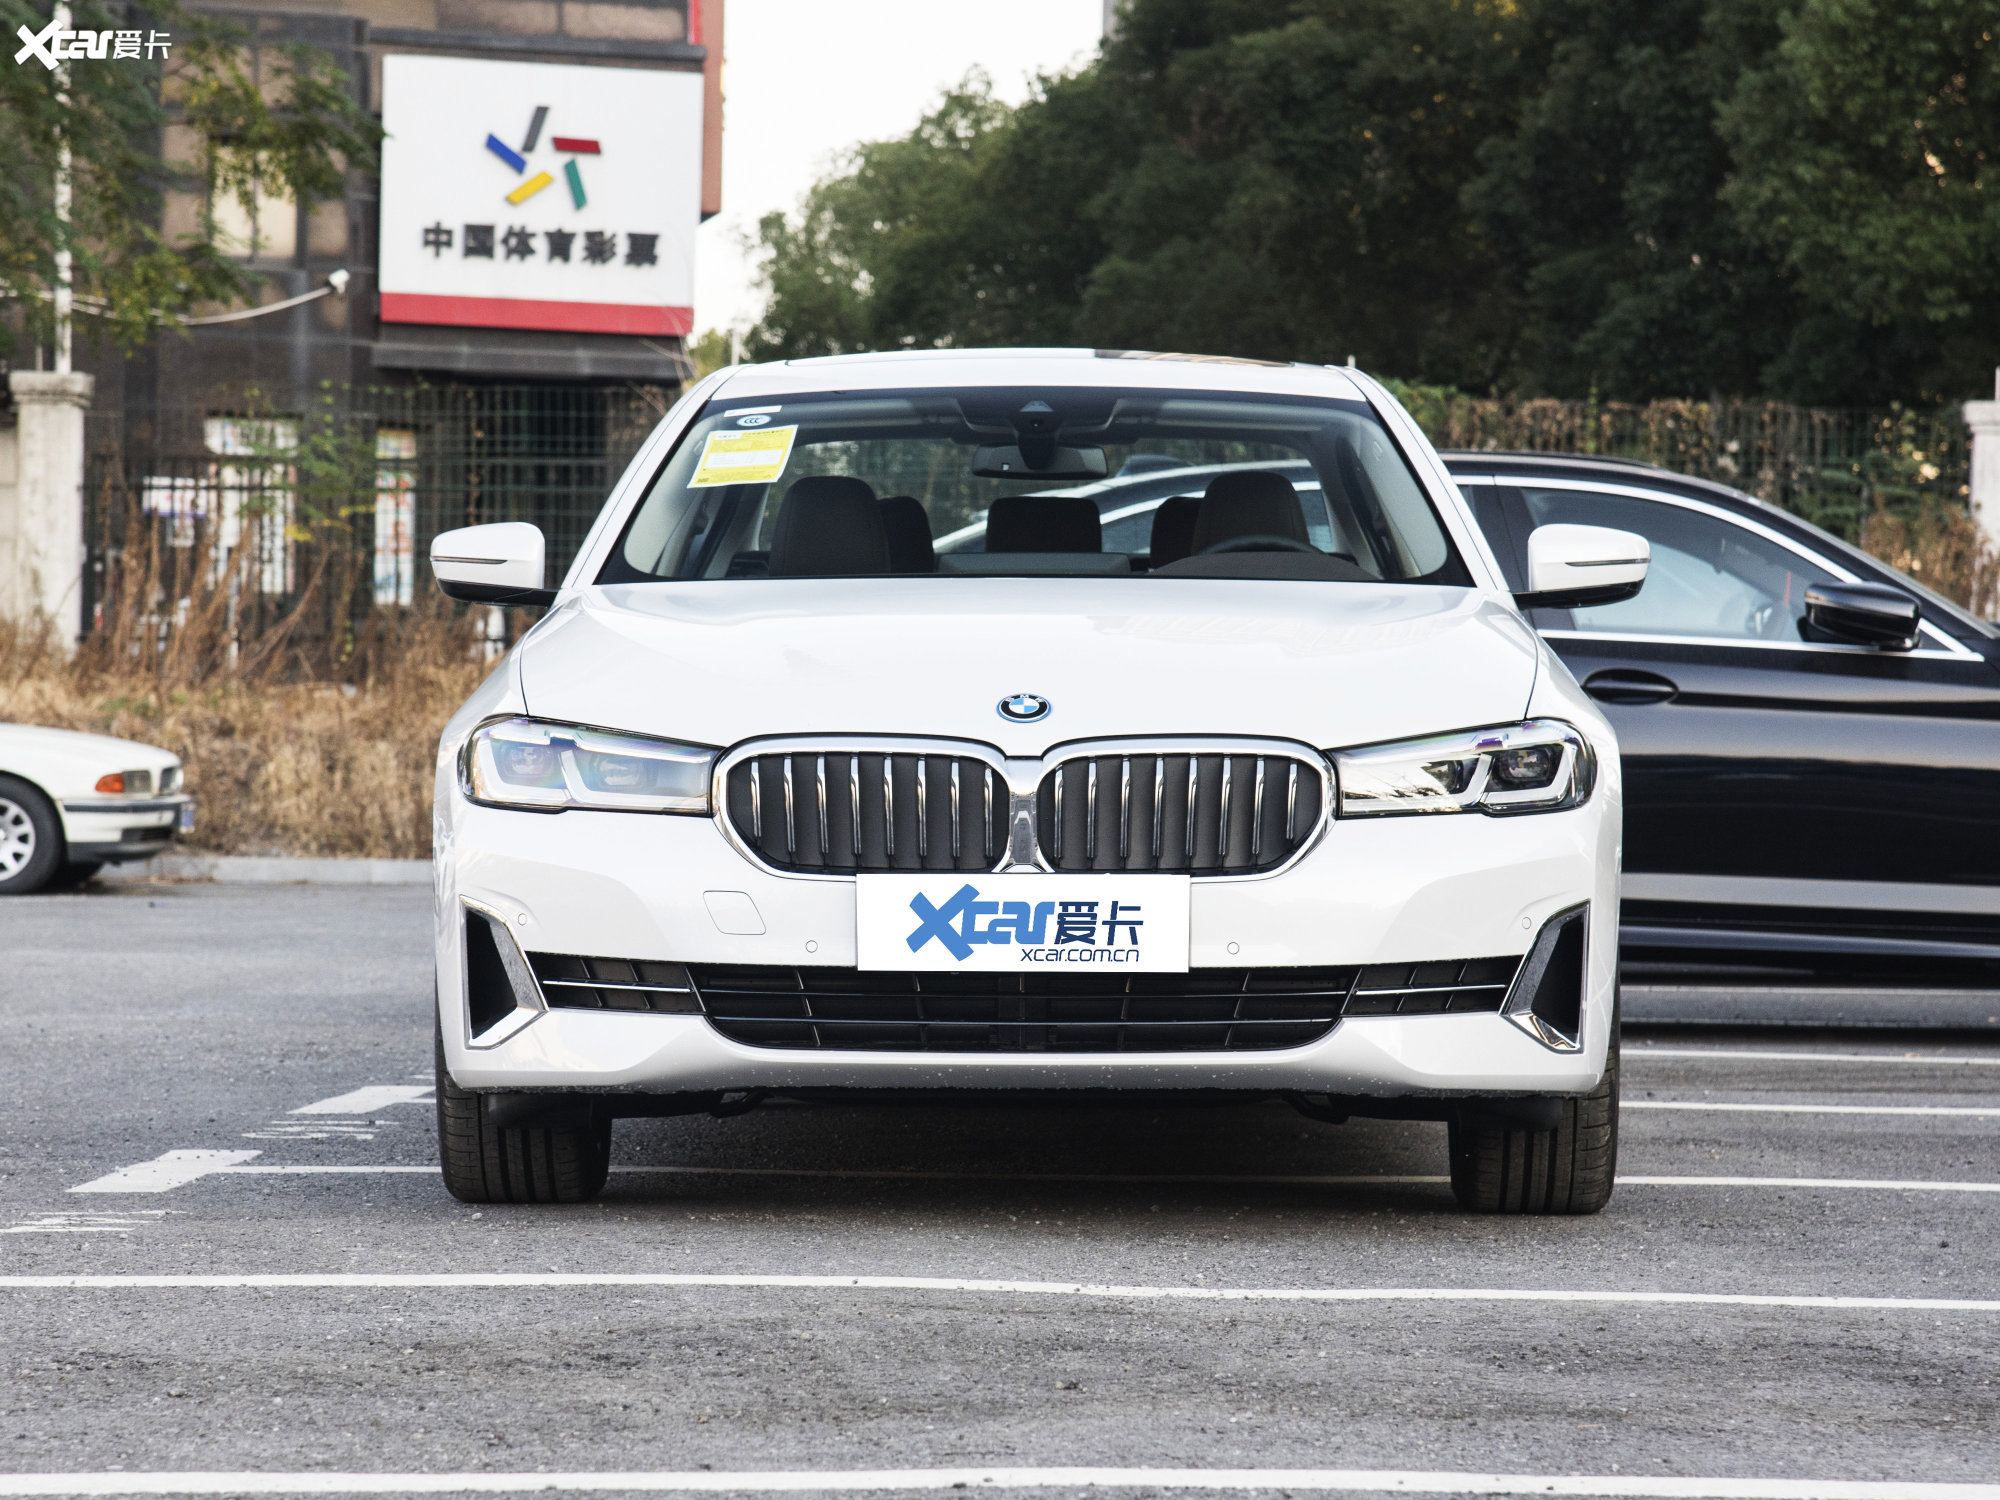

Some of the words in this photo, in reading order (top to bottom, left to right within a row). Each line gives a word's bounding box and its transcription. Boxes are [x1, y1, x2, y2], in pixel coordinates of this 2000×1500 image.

[423, 221, 660, 267] 中国体育彩票
[1020, 949, 1139, 962] xcar.com.cn
